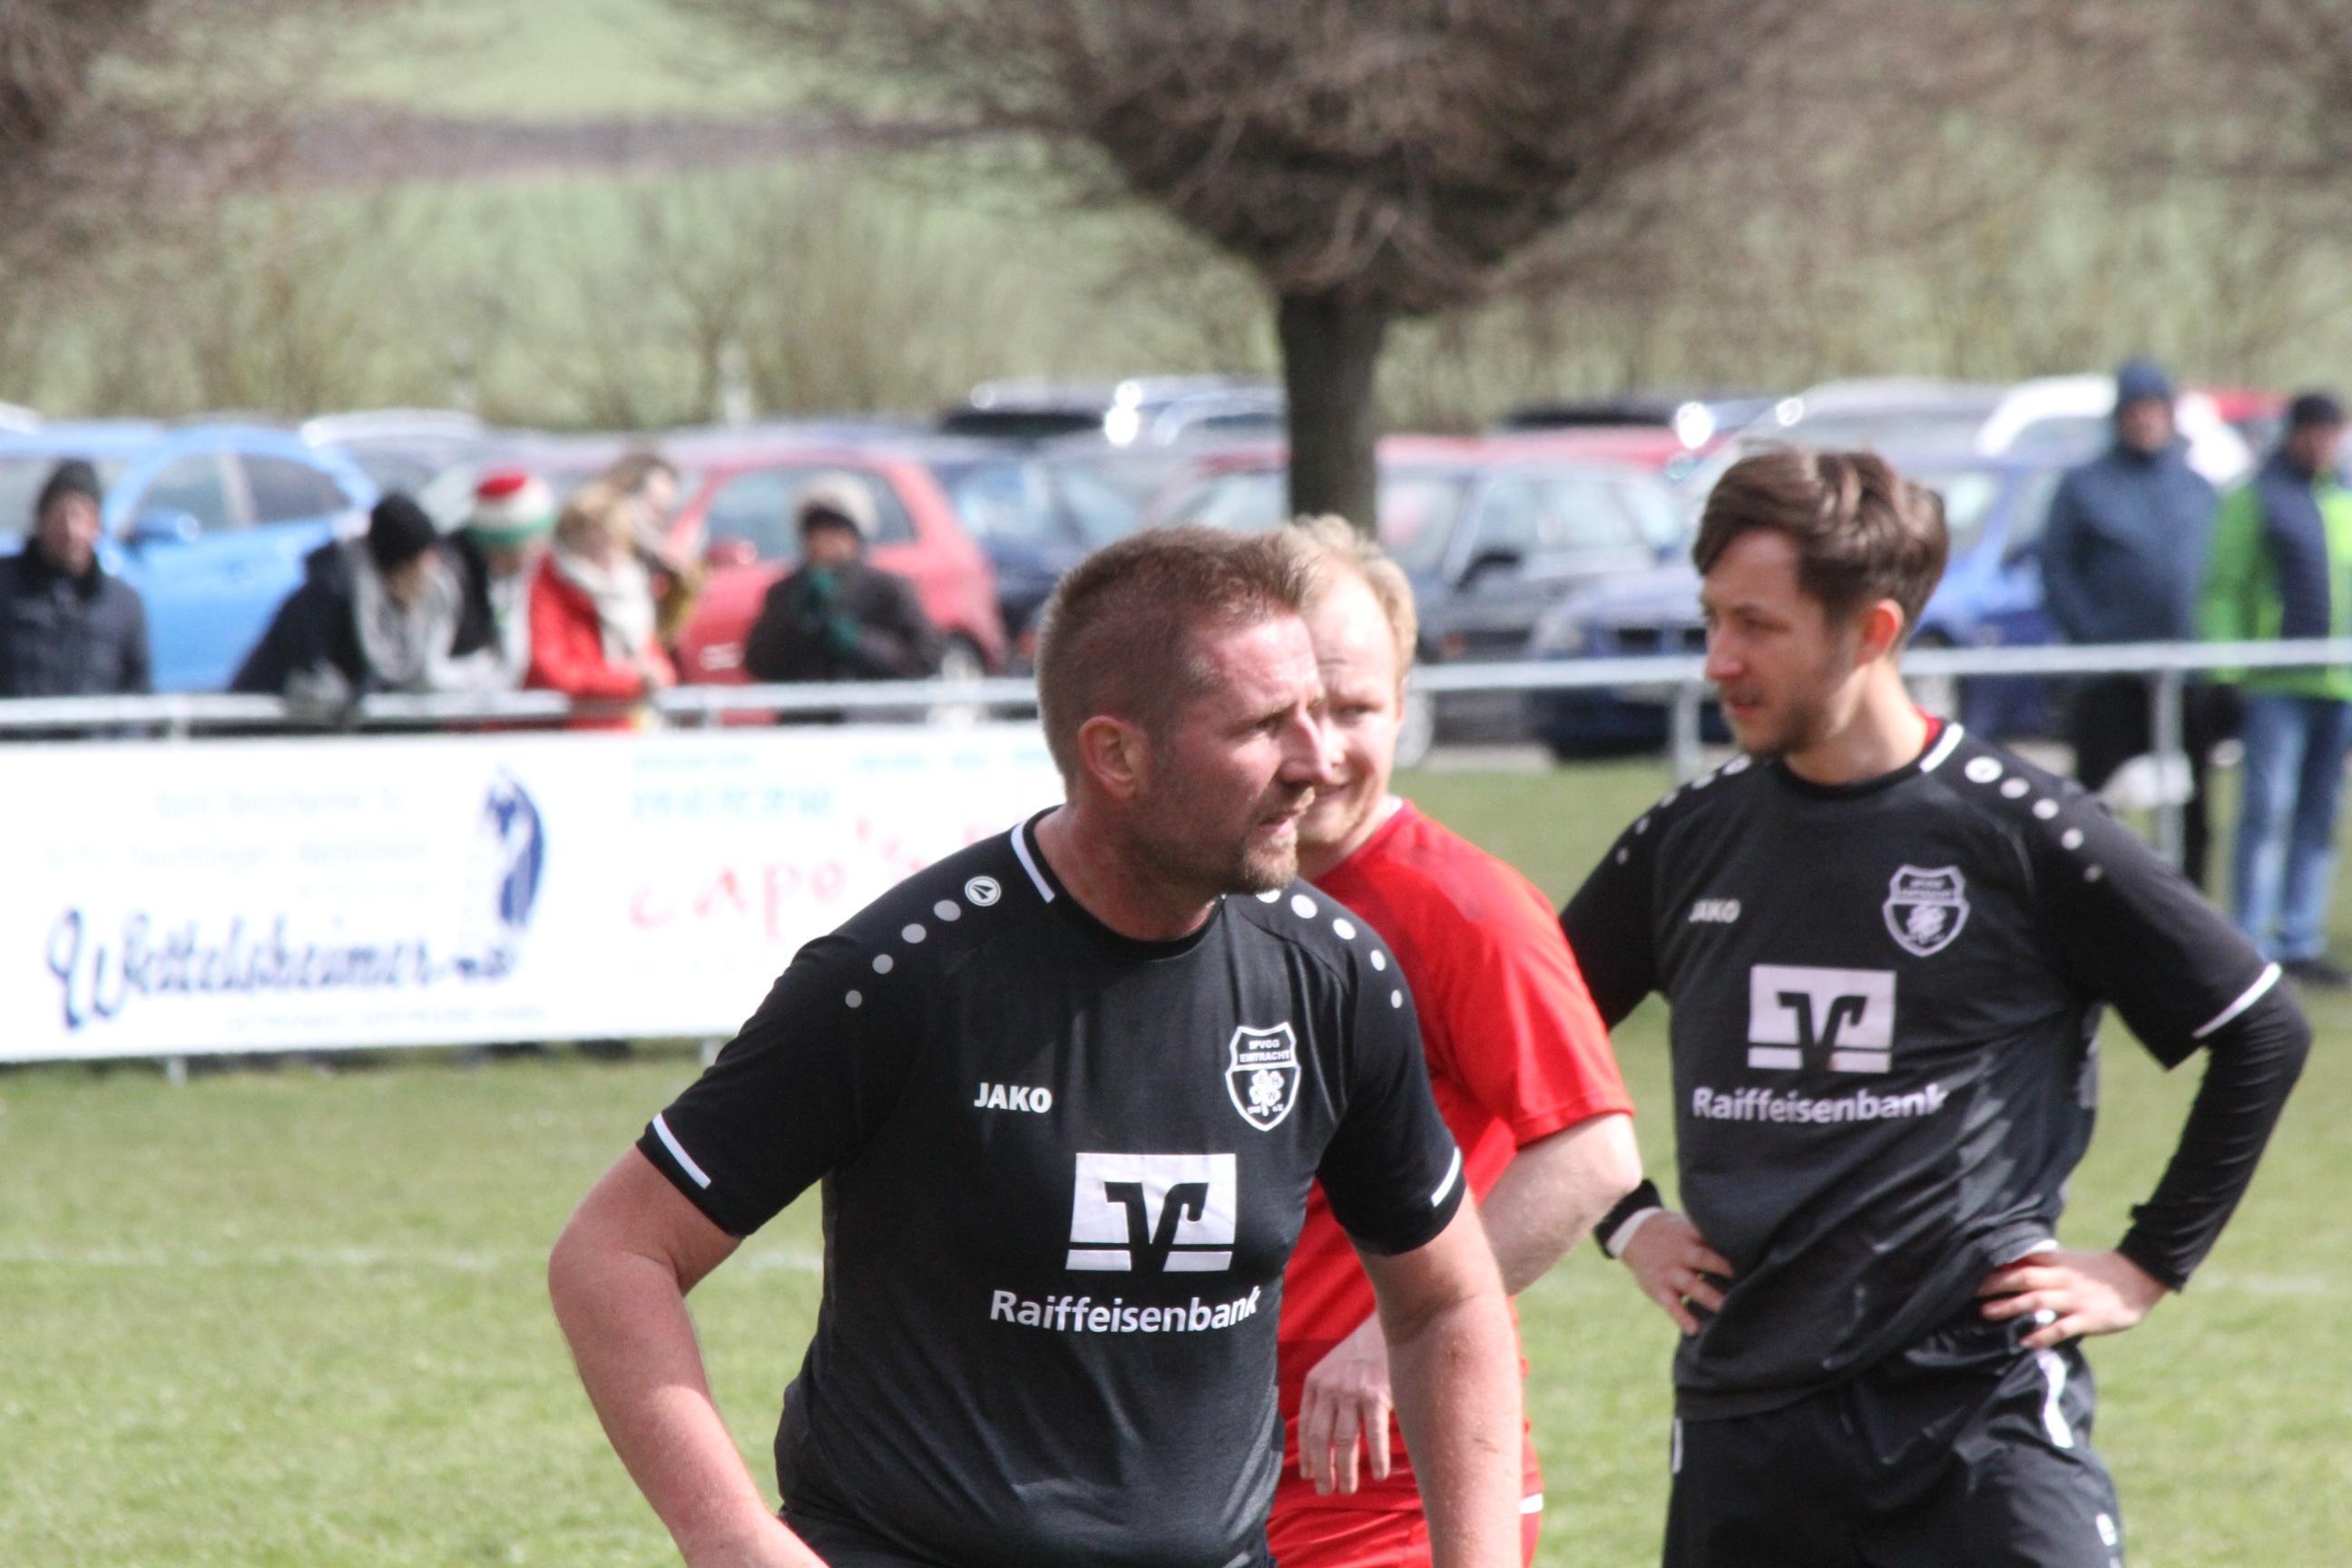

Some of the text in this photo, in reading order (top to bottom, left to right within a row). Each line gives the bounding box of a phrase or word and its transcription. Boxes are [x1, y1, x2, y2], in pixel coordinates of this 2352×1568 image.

[974, 1082, 1053, 1113] JAKO
[1692, 1084, 1949, 1124] Raiffeisenbank
[990, 1286, 1261, 1333] Raiffeisenbank
